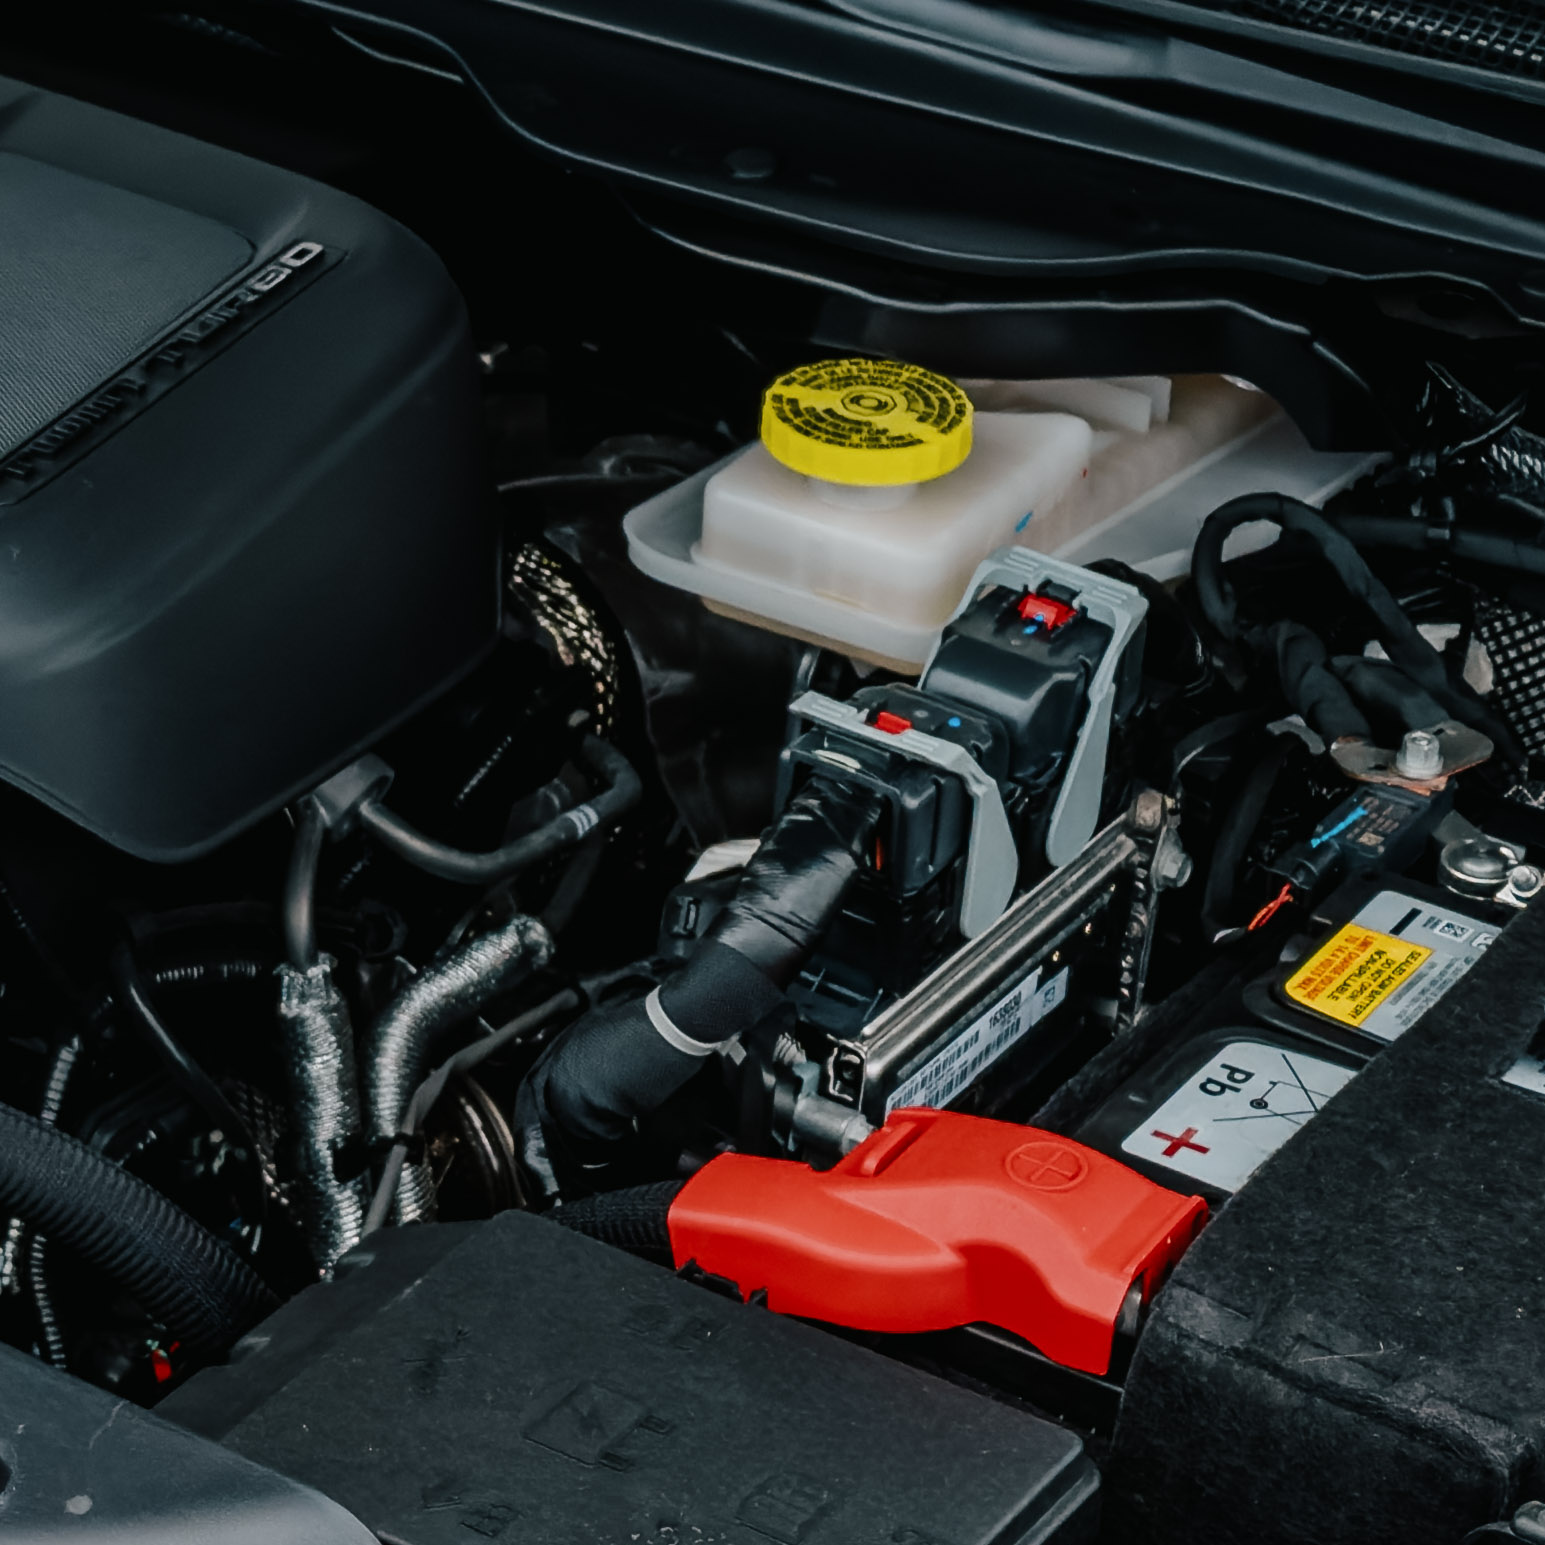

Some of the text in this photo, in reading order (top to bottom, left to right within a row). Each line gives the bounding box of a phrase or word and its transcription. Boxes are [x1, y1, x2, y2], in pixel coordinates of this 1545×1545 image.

[146, 240, 324, 373] TURBO
[1327, 949, 1387, 1001] NON-SPILLABLE
[1369, 968, 1384, 982] NOT
[1382, 958, 1397, 969] DO
[1392, 950, 1423, 976] SEALED
[1379, 975, 1395, 991] AGM
[1198, 1062, 1255, 1097] Pb
